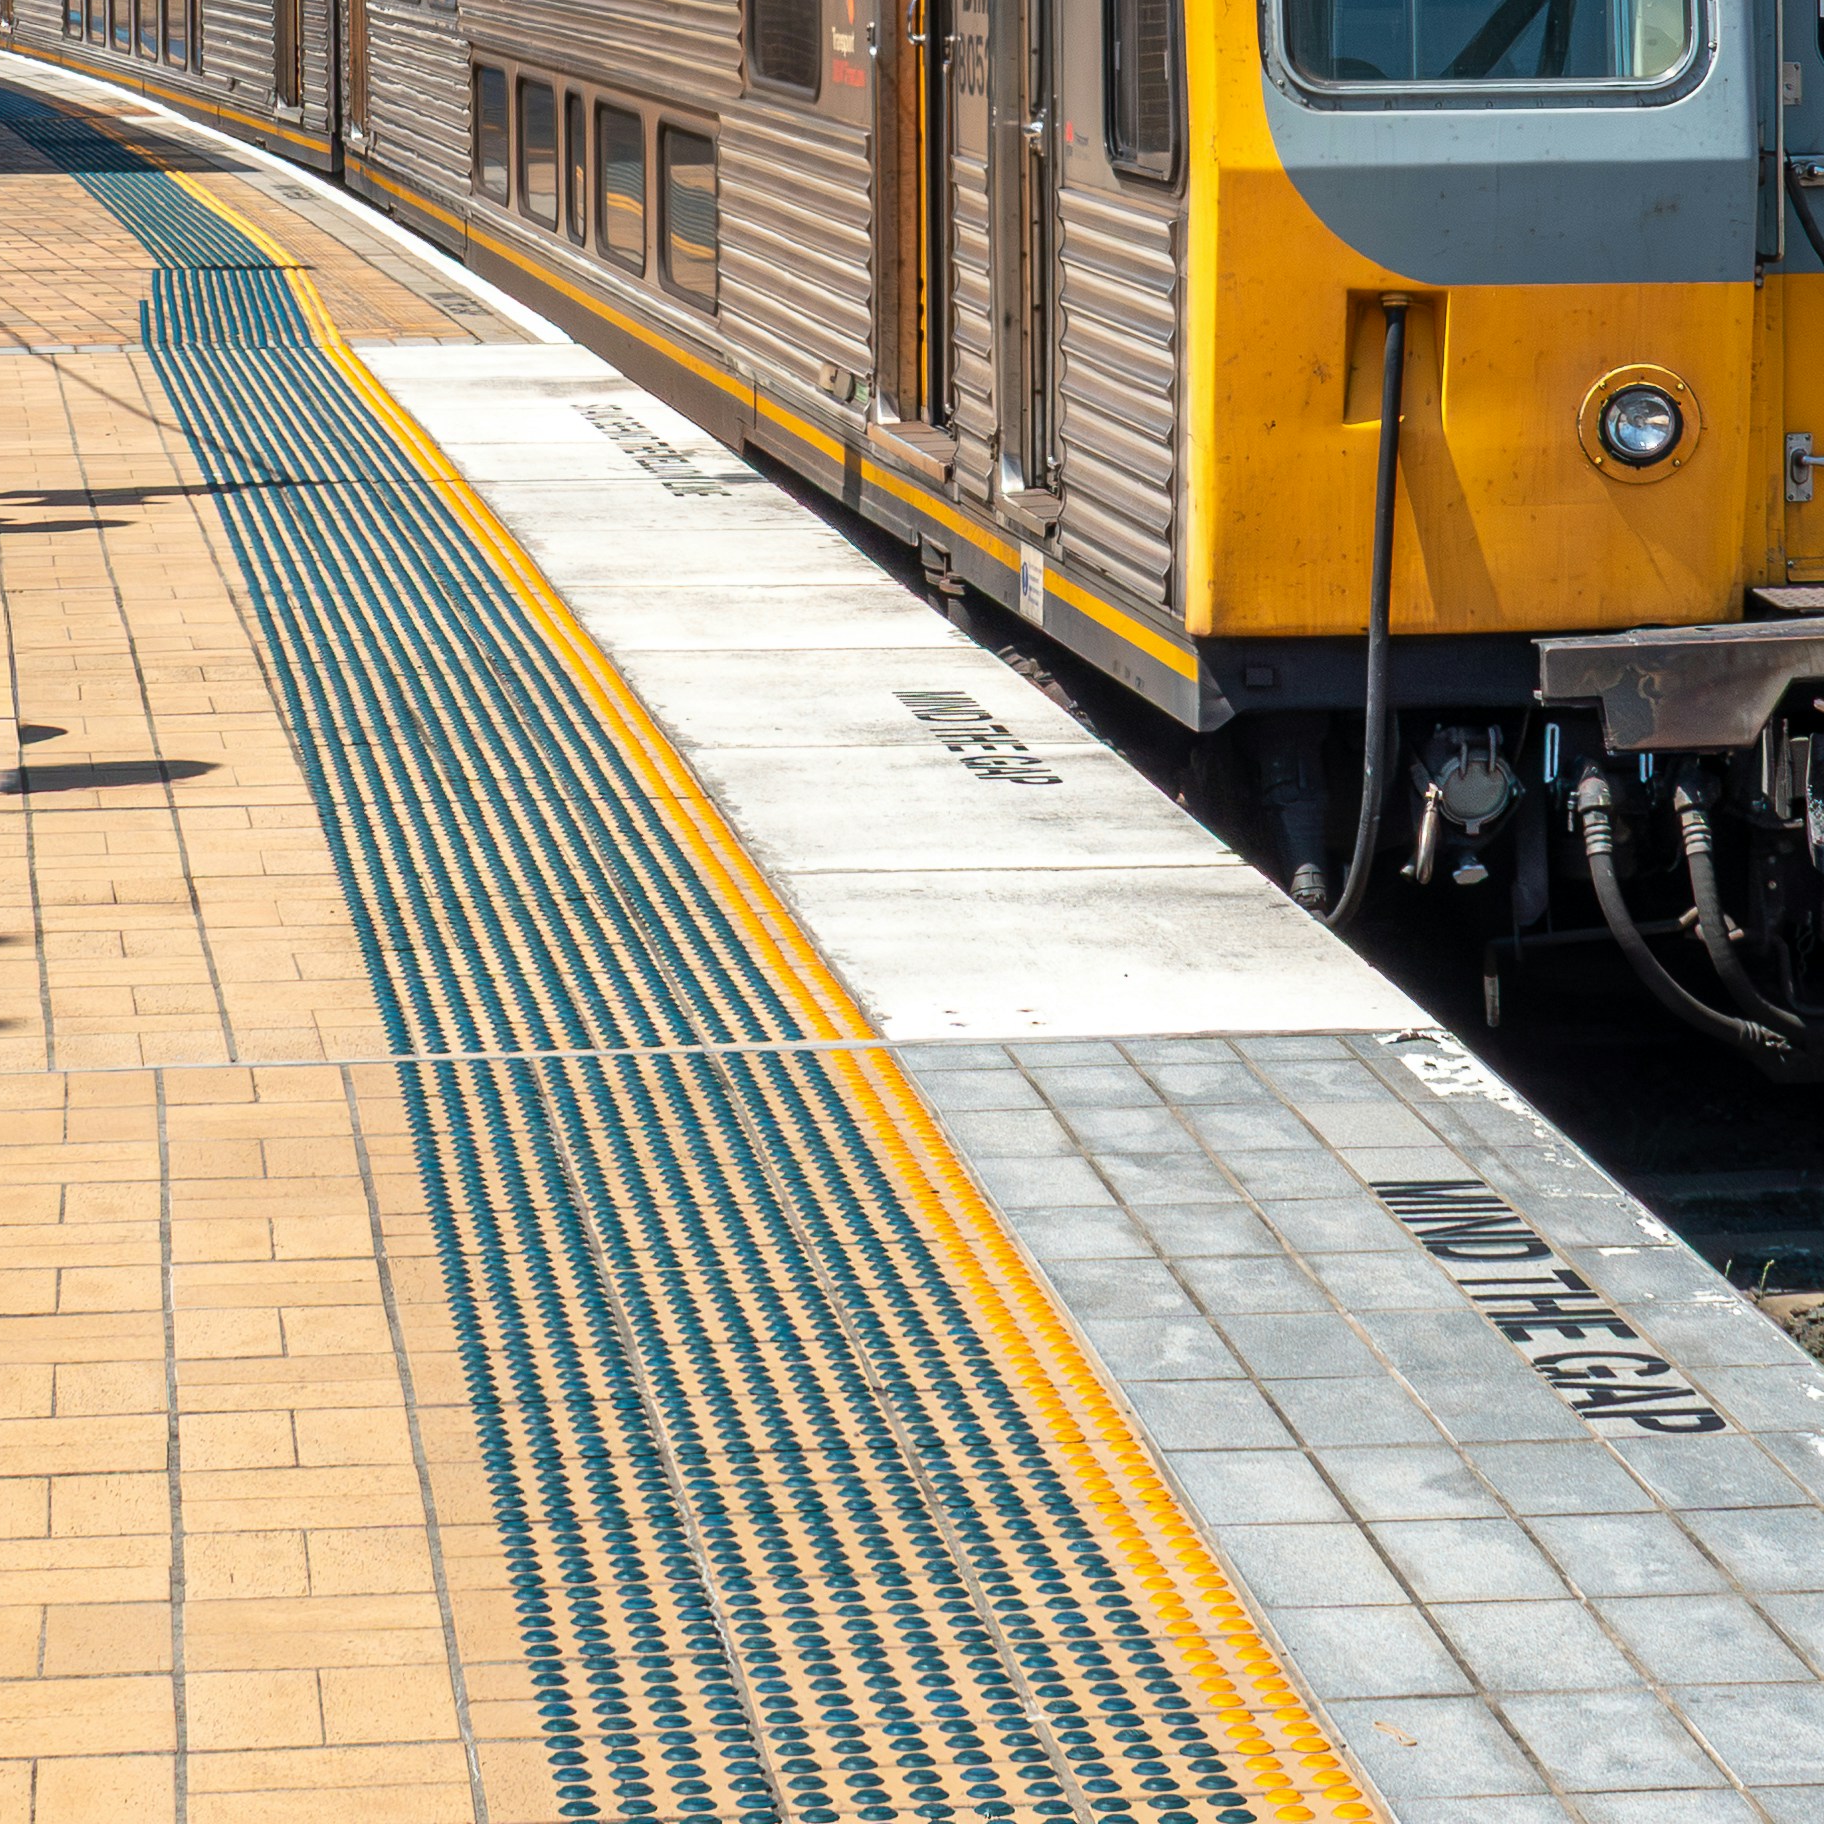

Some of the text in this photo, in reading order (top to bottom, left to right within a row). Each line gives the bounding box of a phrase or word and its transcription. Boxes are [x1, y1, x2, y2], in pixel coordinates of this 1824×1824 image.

[958, 31, 989, 96] 805
[892, 691, 1063, 785] MIND THE GAP
[1369, 1179, 1726, 1434] MIND THE GAP
